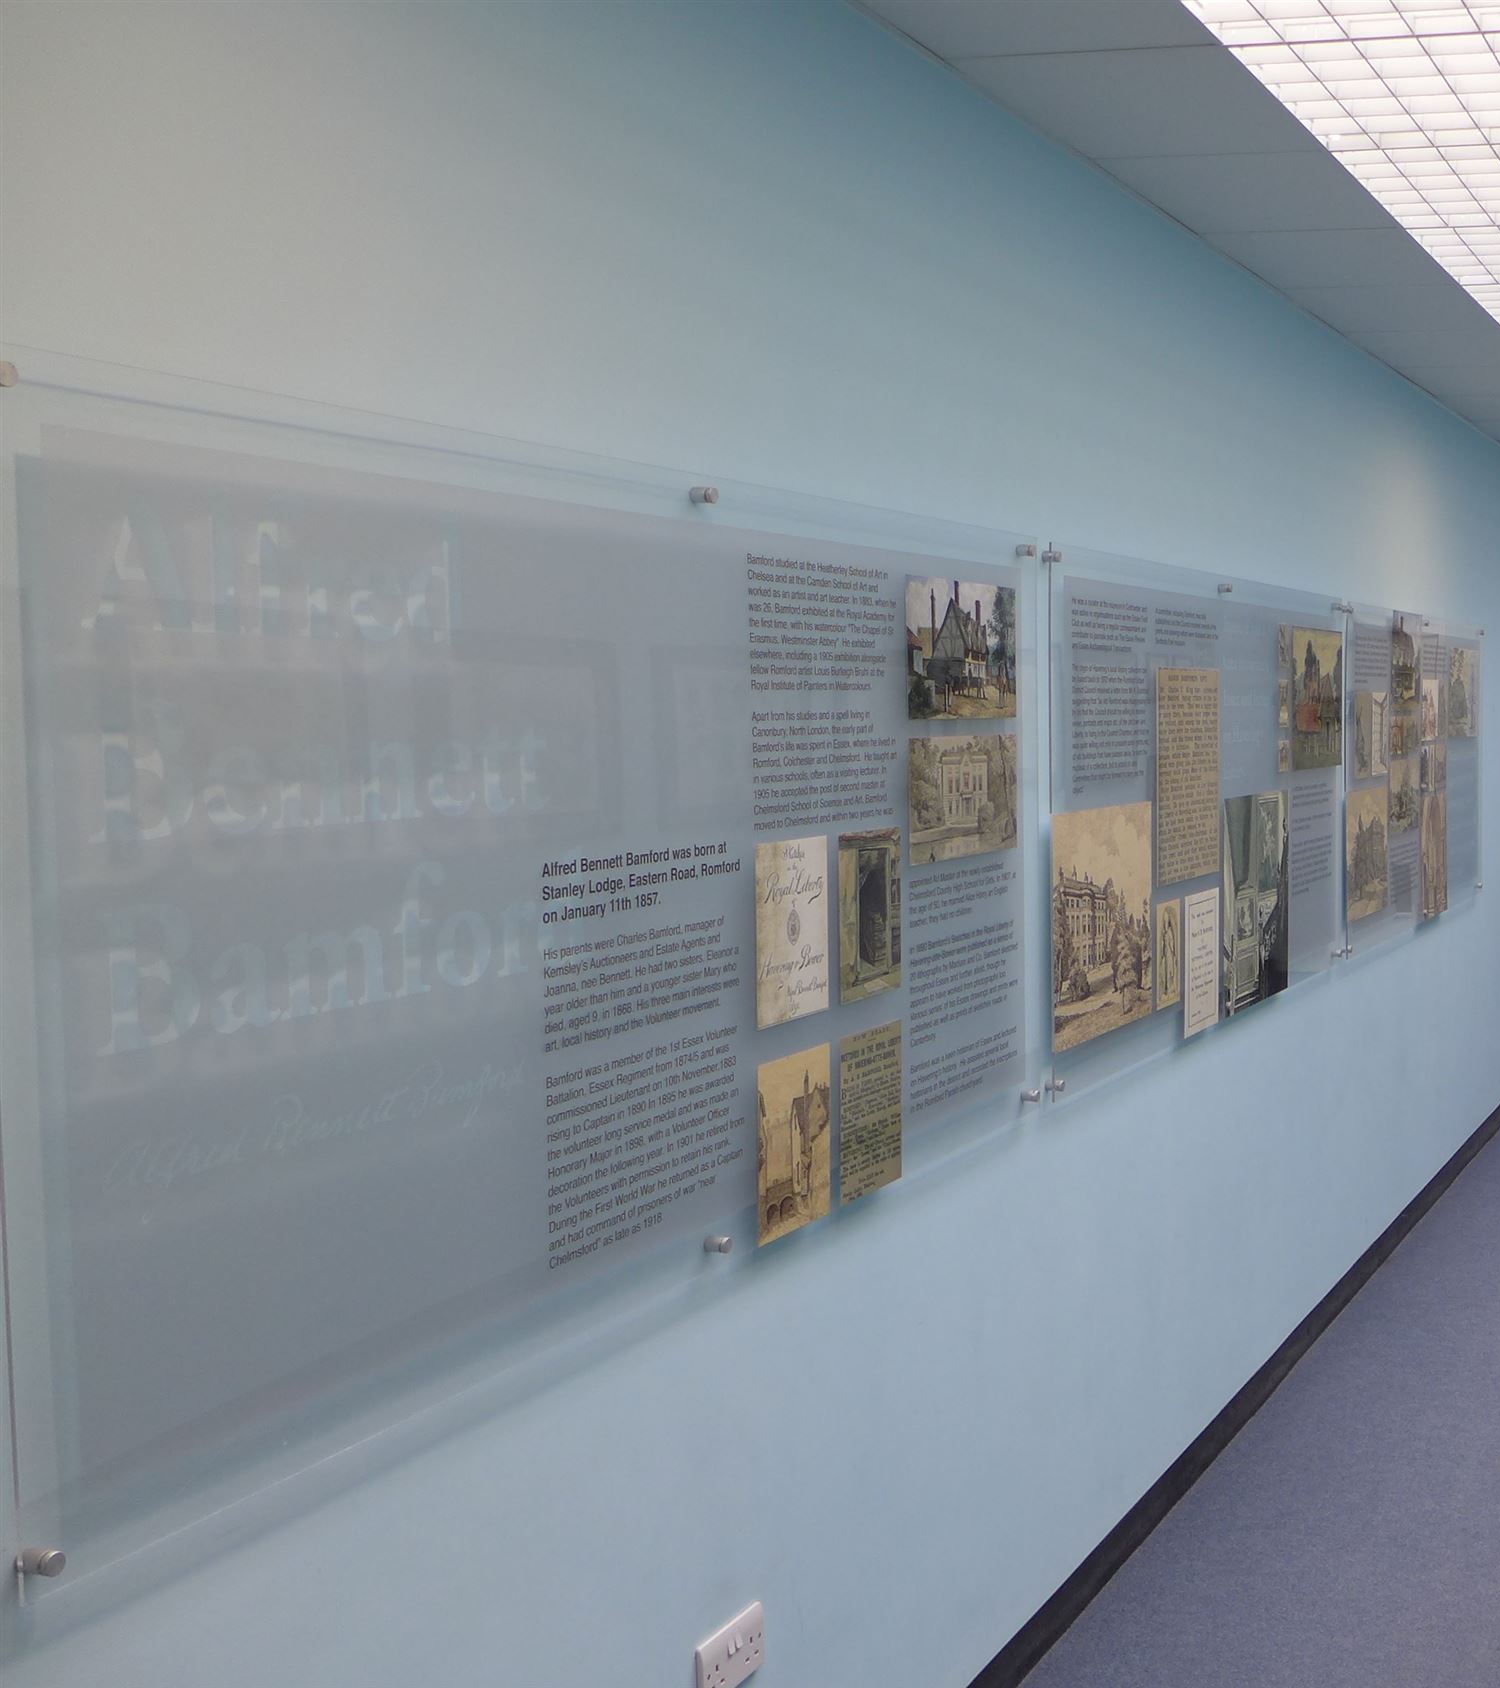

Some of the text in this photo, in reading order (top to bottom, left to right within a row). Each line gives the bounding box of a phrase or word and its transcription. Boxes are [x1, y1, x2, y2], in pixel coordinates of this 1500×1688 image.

[542, 842, 727, 879] Alfred Bennett Bamford was born at
[542, 859, 741, 902] Stanley Lodge, Eastern Road, Romford
[542, 891, 661, 926] on January 11th 1857.
[543, 948, 559, 962] His
[560, 942, 593, 962] parents
[594, 939, 615, 952] were
[616, 932, 648, 948] Charles
[684, 919, 716, 934] manager
[589, 951, 638, 970] Auctioneers
[655, 942, 680, 957] Estate
[681, 936, 706, 953] Agents
[544, 961, 737, 1020] year older than him younger sister Mary who
[635, 965, 647, 978] He
[648, 961, 663, 975] had
[664, 960, 678, 972] two
[568, 1012, 591, 1031] aged
[636, 998, 650, 1012] His
[650, 994, 671, 1008] three
[672, 988, 691, 1003] main
[723, 977, 740, 990] were
[562, 1031, 583, 1049] local
[584, 1027, 612, 1043] history
[645, 1009, 681, 1027] Volunteer
[546, 1025, 738, 1090] Bamford member 1st Essex Volunteer
[589, 1078, 615, 1095] Essex
[616, 1064, 654, 1087] Regiment
[655, 1060, 673, 1075] from
[546, 1095, 608, 1126] commissioned
[609, 1082, 651, 1106] Lieutenant
[663, 1072, 681, 1089] 10th
[547, 1127, 571, 1144] rising
[547, 1156, 588, 1180] Honorary
[589, 1147, 613, 1165] Major
[648, 1127, 664, 1144] with
[671, 1114, 707, 1136] Volunteer
[563, 1090, 729, 1157] volunteer long service medal made
[548, 1172, 593, 1198] decoration
[610, 1153, 645, 1175] following
[675, 1132, 694, 1151] 1901
[706, 1120, 729, 1139] retired
[729, 1116, 745, 1130] from
[564, 1183, 610, 1210] Volunteers
[610, 1174, 628, 1192] with
[629, 1160, 671, 1188] permission
[680, 1147, 701, 1165] retain
[702, 1143, 713, 1156] his
[567, 1226, 584, 1245] had
[585, 1208, 626, 1237] command
[682, 1182, 697, 1197] war
[594, 1197, 613, 1216] First
[614, 1187, 639, 1208] World
[639, 1182, 656, 1198] War
[668, 1163, 699, 1186] returned
[615, 1226, 630, 1242] late
